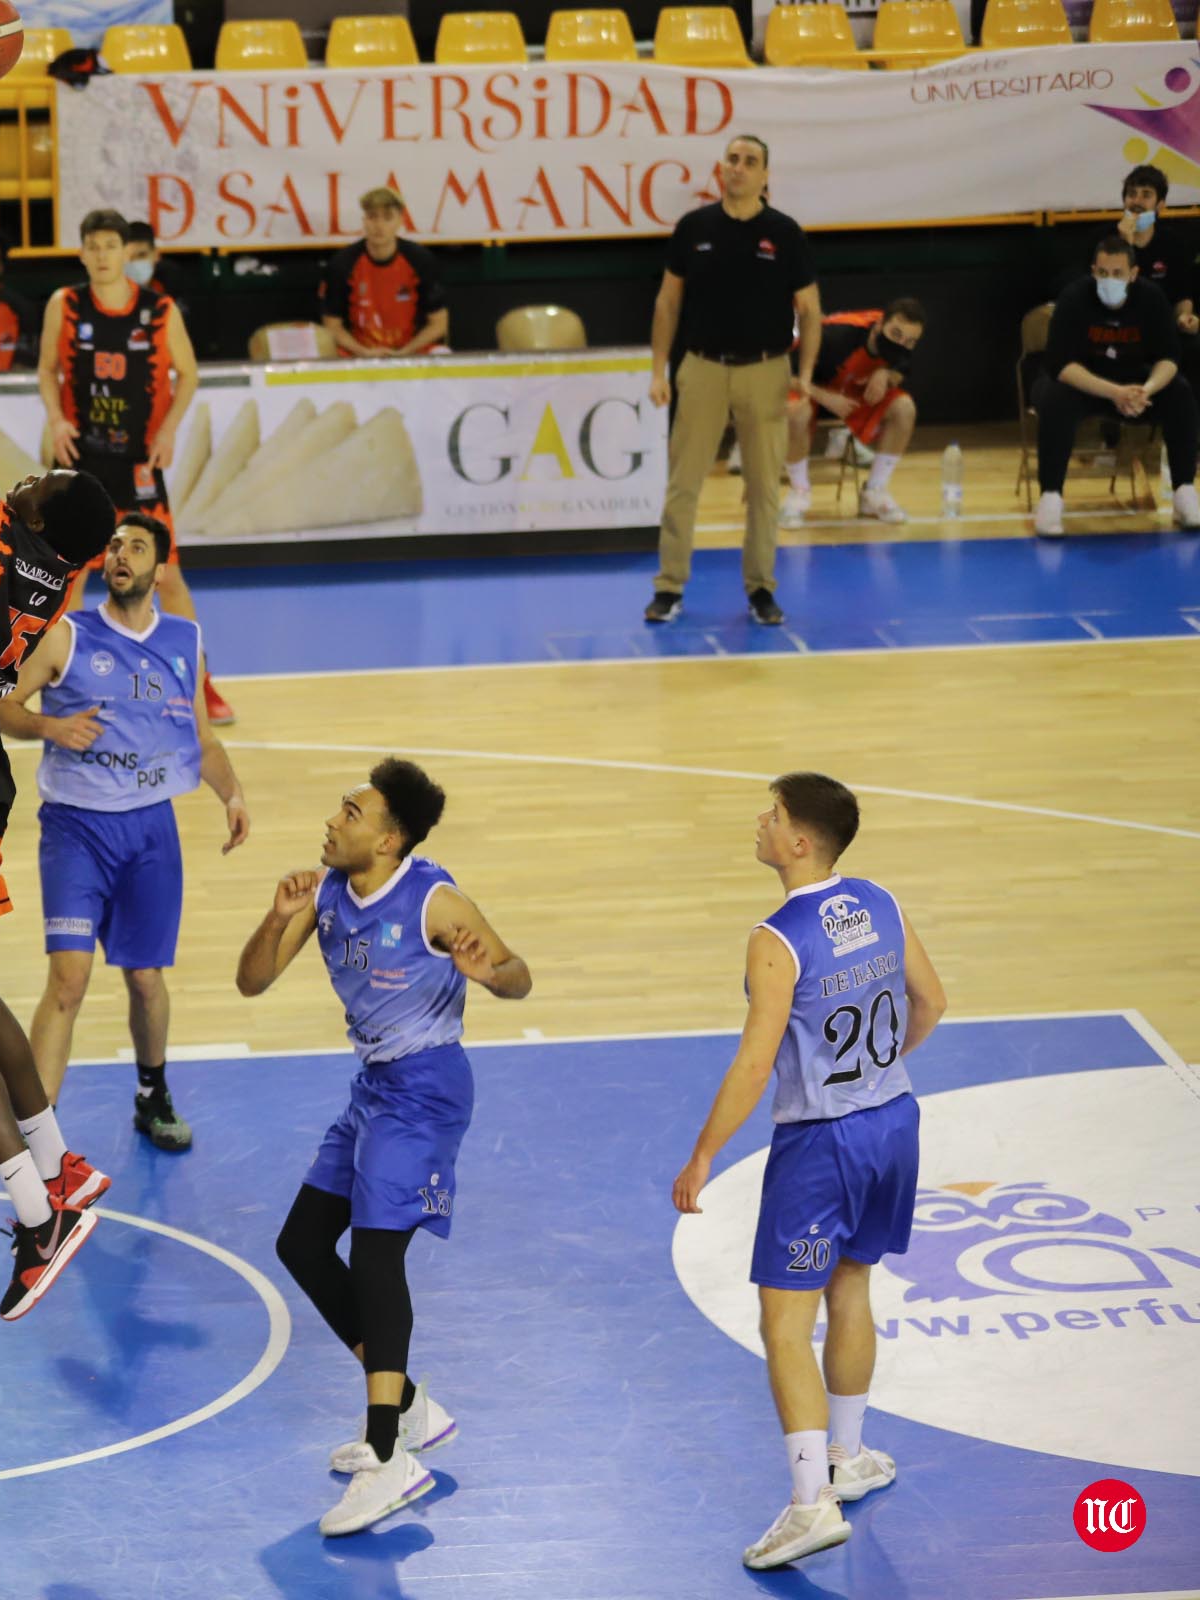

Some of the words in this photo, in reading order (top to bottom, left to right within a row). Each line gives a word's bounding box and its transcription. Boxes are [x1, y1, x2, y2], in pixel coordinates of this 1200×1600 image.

[910, 69, 1114, 104] UNIVERSITARIO
[447, 397, 652, 486] GAG
[128, 673, 162, 701] 18
[81, 750, 138, 770] CONS
[341, 936, 371, 972] 15
[820, 970, 850, 998] DE
[851, 951, 899, 987] HARO
[822, 988, 900, 1088] 20
[786, 1237, 832, 1272] 20
